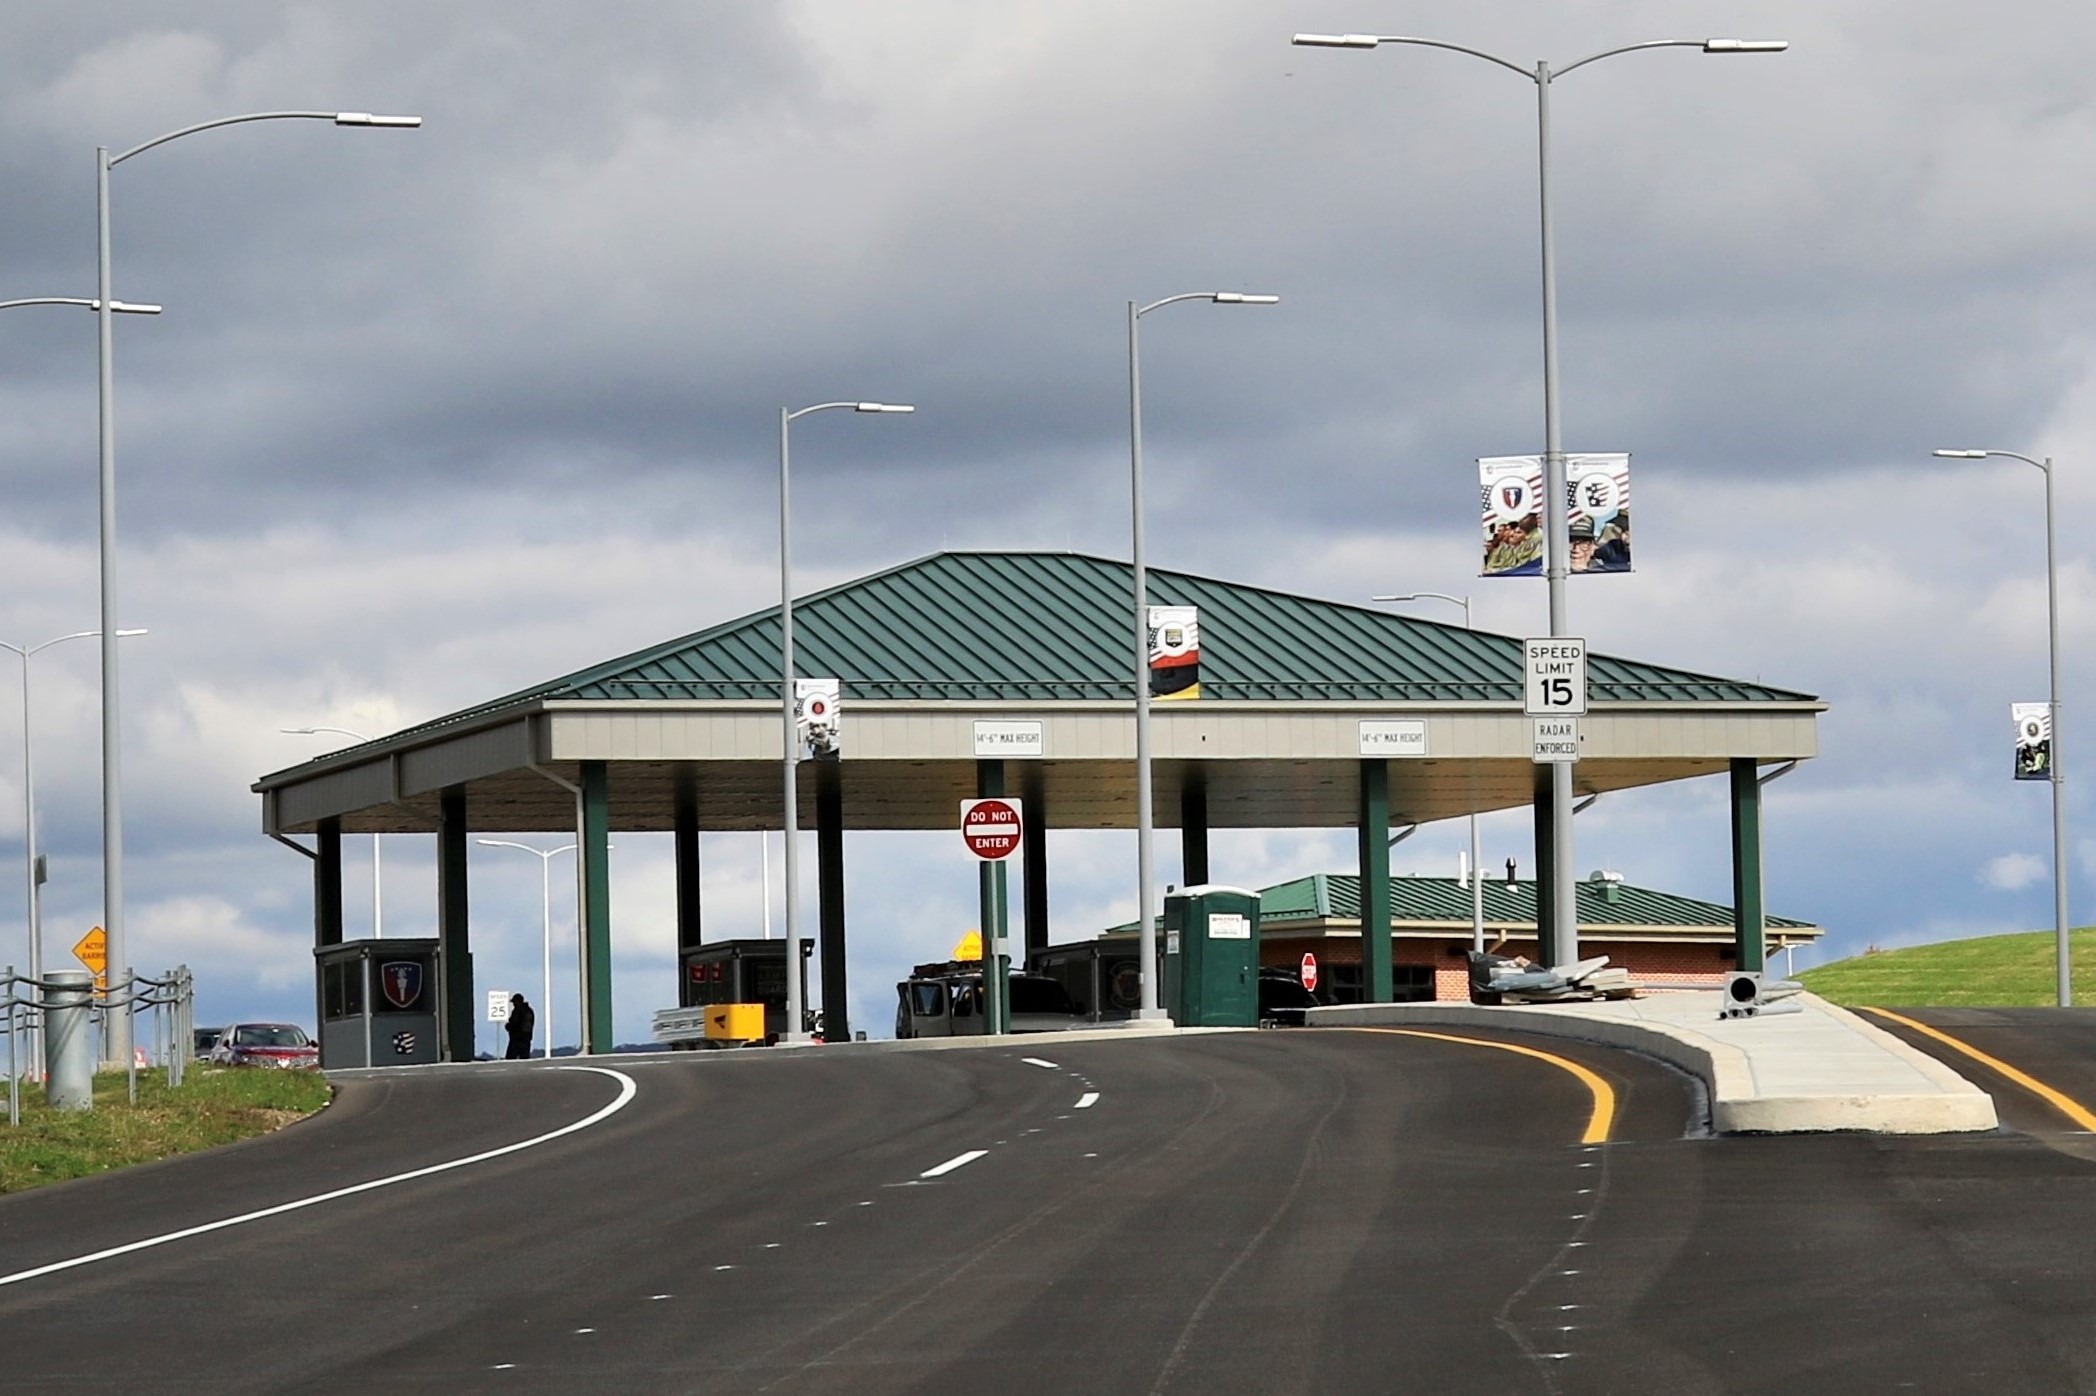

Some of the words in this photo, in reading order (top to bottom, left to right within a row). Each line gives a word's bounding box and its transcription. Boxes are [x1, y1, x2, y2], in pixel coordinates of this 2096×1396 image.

[1530, 647, 1580, 658] SPEED
[1535, 663, 1574, 674] LIMIT
[1541, 679, 1573, 706] 15
[1540, 725, 1571, 736] RADAR
[1000, 733, 1014, 743] MAX
[1015, 733, 1039, 743] HEIGHT
[1384, 733, 1398, 743] MAX
[1400, 733, 1422, 743] HEIGHT
[1535, 743, 1576, 754] ENFORCED
[971, 812, 986, 822] DO
[991, 811, 1012, 821] NOT
[975, 838, 1009, 848] ENTER
[490, 1006, 506, 1018] 25
